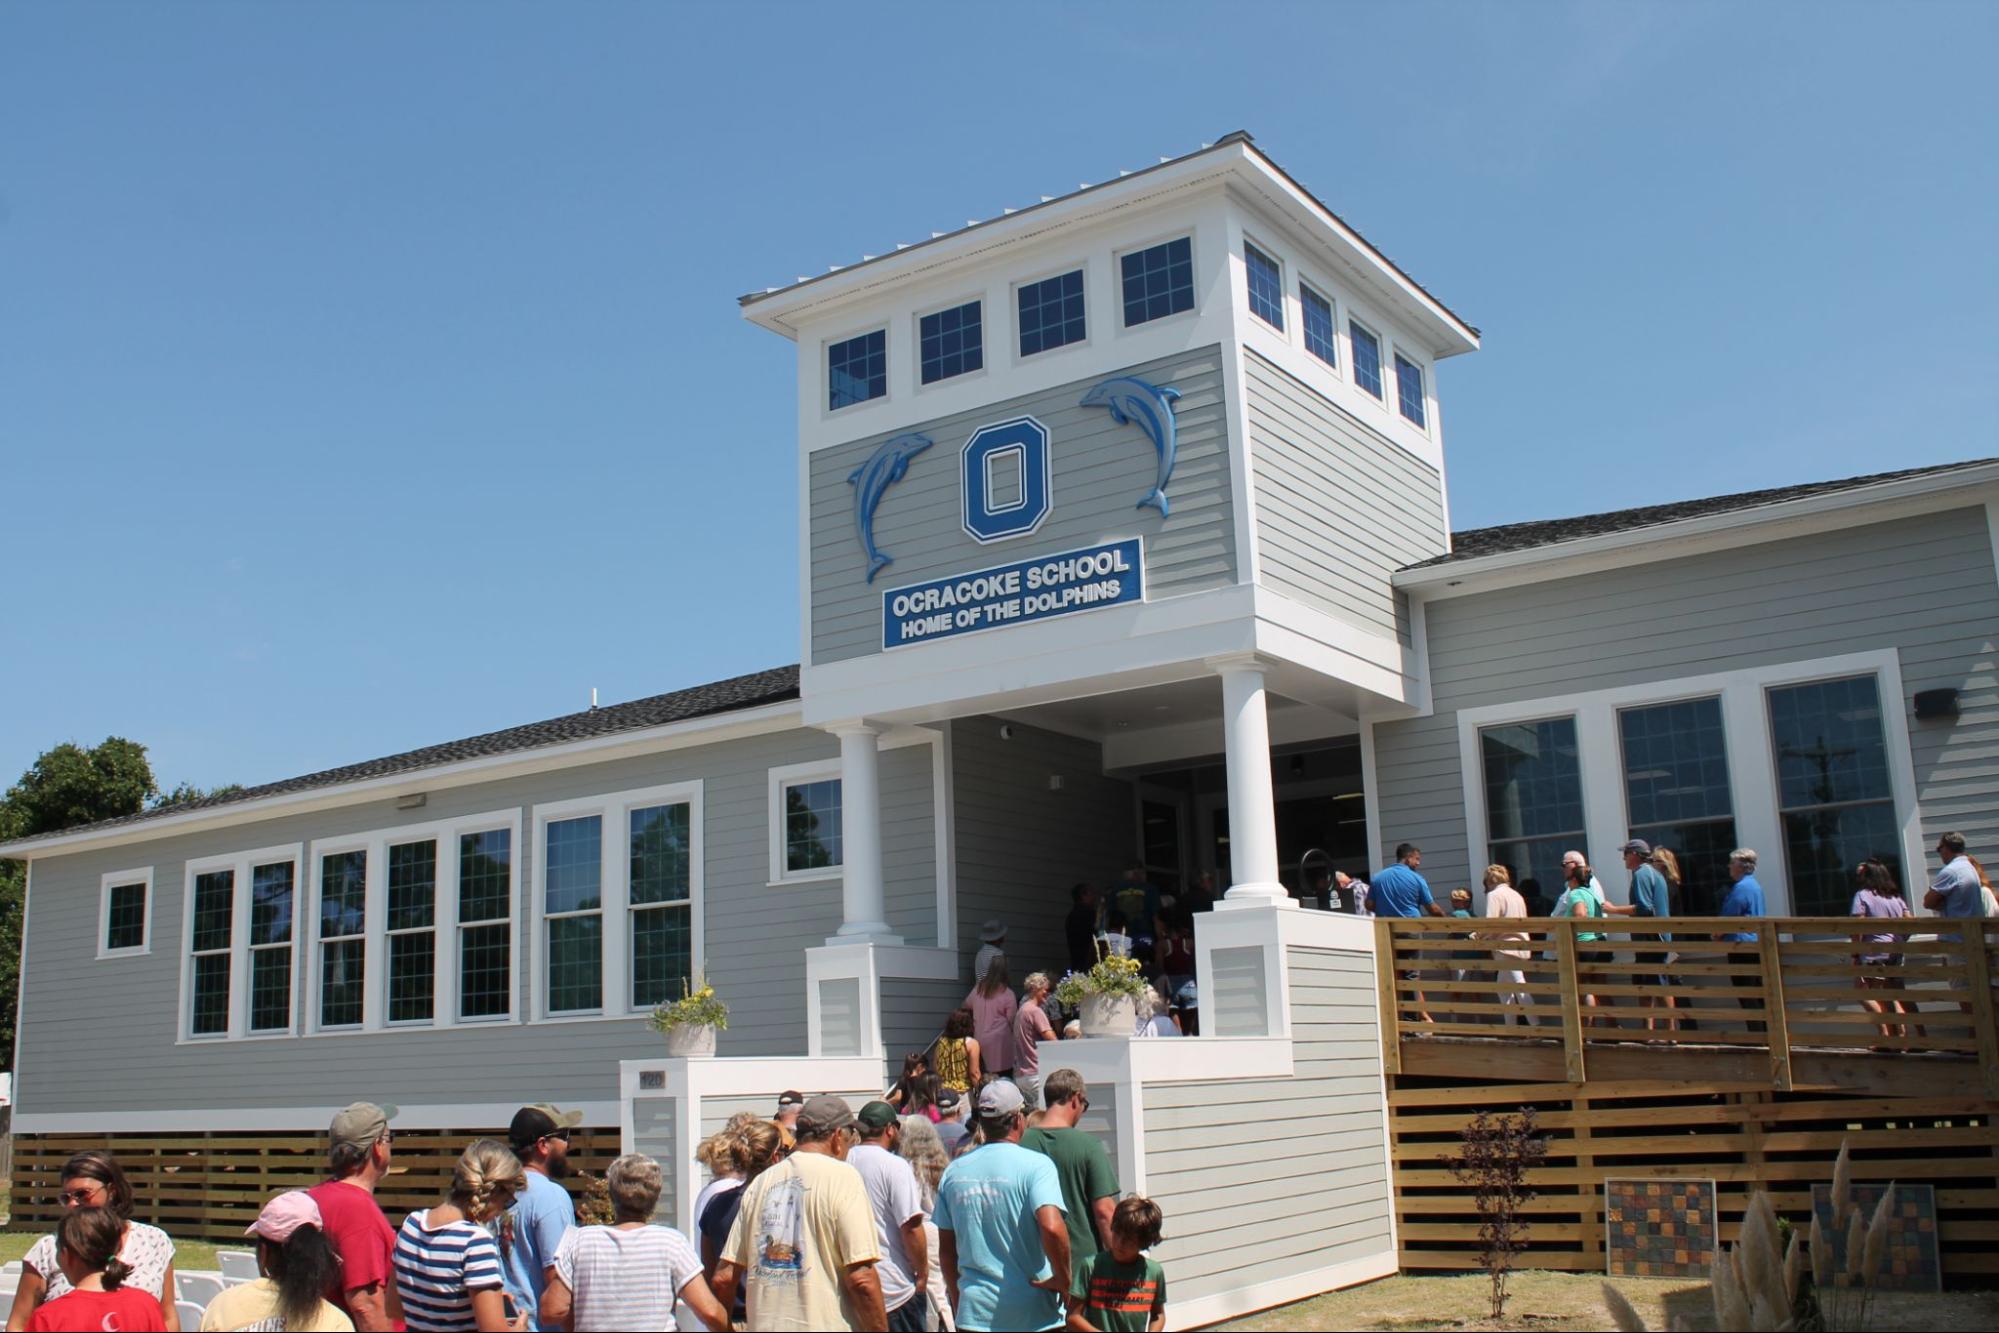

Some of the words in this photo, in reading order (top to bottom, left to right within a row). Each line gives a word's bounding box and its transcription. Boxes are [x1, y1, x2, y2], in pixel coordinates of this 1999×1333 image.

[960, 414, 1053, 545] O
[893, 571, 1020, 617] OCRACOKE
[1026, 549, 1130, 590] SCHOOL
[901, 612, 953, 640] HOME
[955, 606, 981, 628] OF
[984, 598, 1021, 622] THE
[1024, 579, 1121, 615] DOLPHINS
